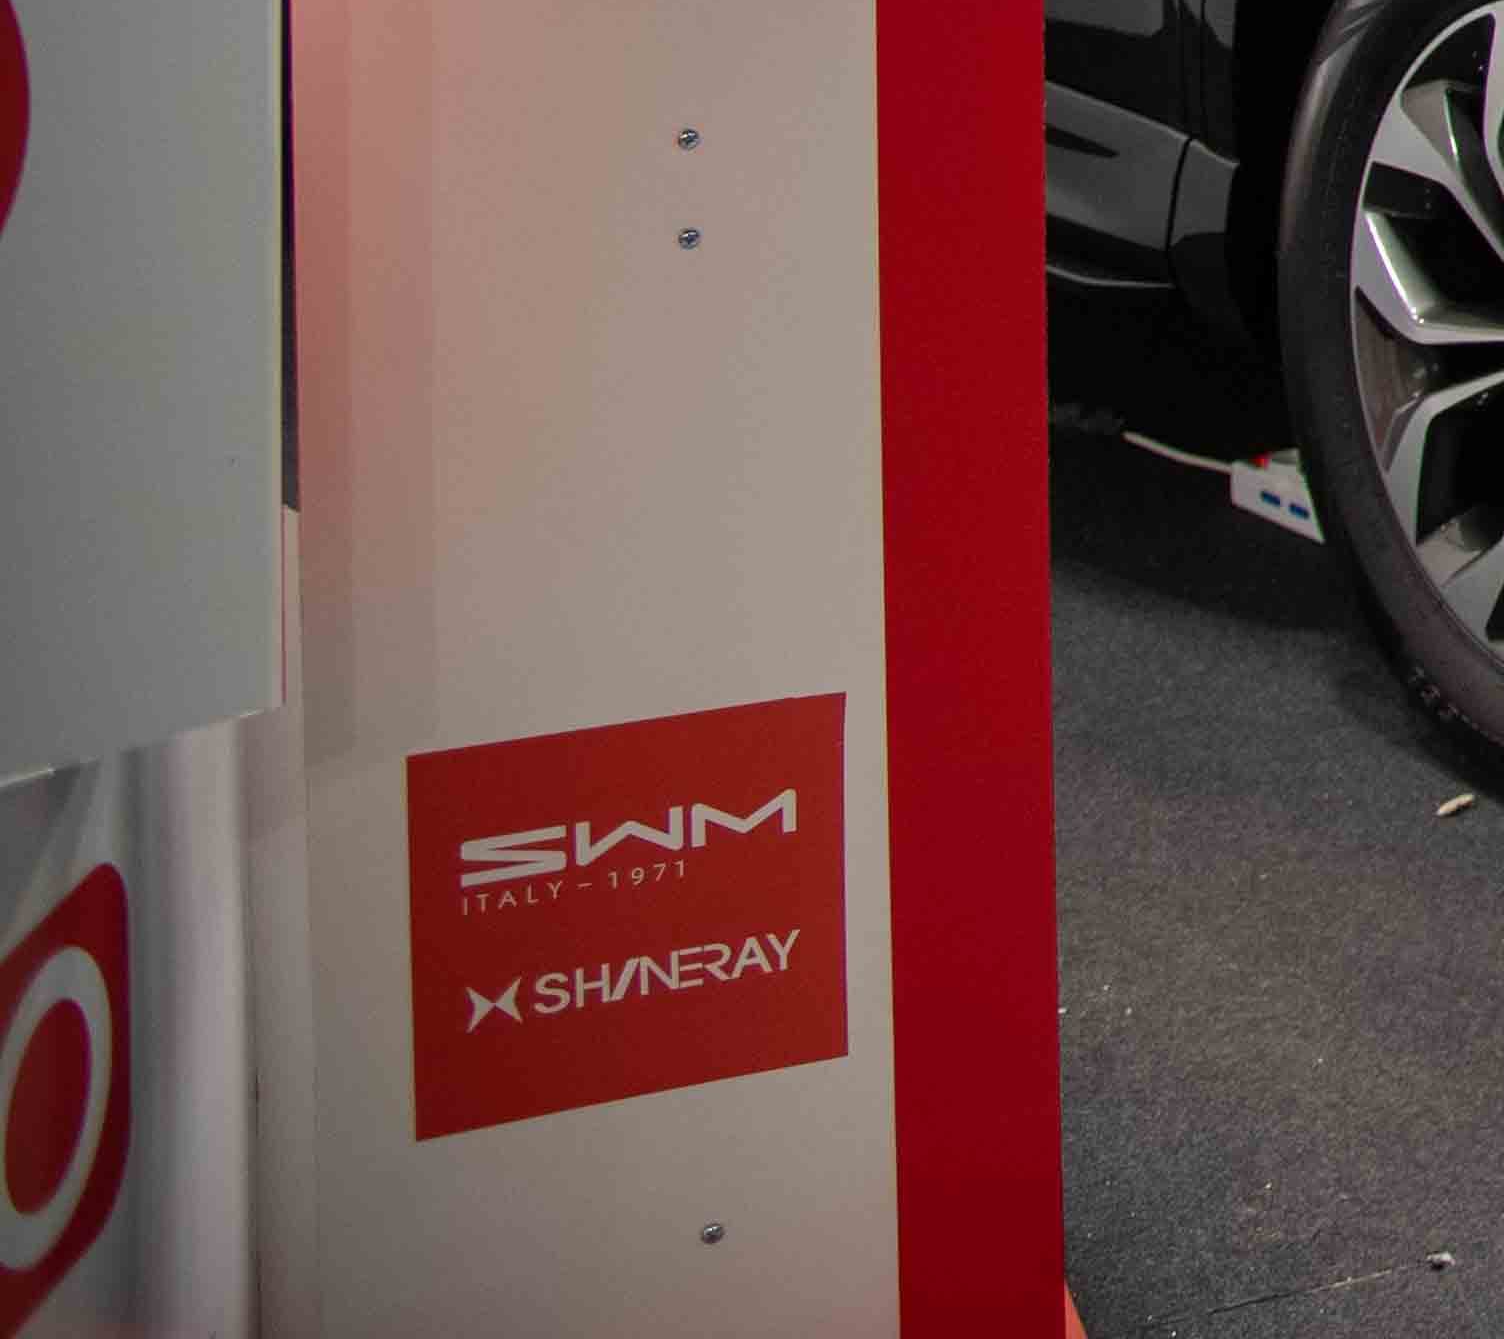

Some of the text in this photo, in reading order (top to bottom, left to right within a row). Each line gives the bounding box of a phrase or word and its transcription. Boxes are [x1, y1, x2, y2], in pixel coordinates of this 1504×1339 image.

[459, 788, 797, 888] SWM
[462, 880, 563, 916] ITALY
[608, 859, 687, 889] 1971
[533, 929, 801, 1015] SHINERAY
